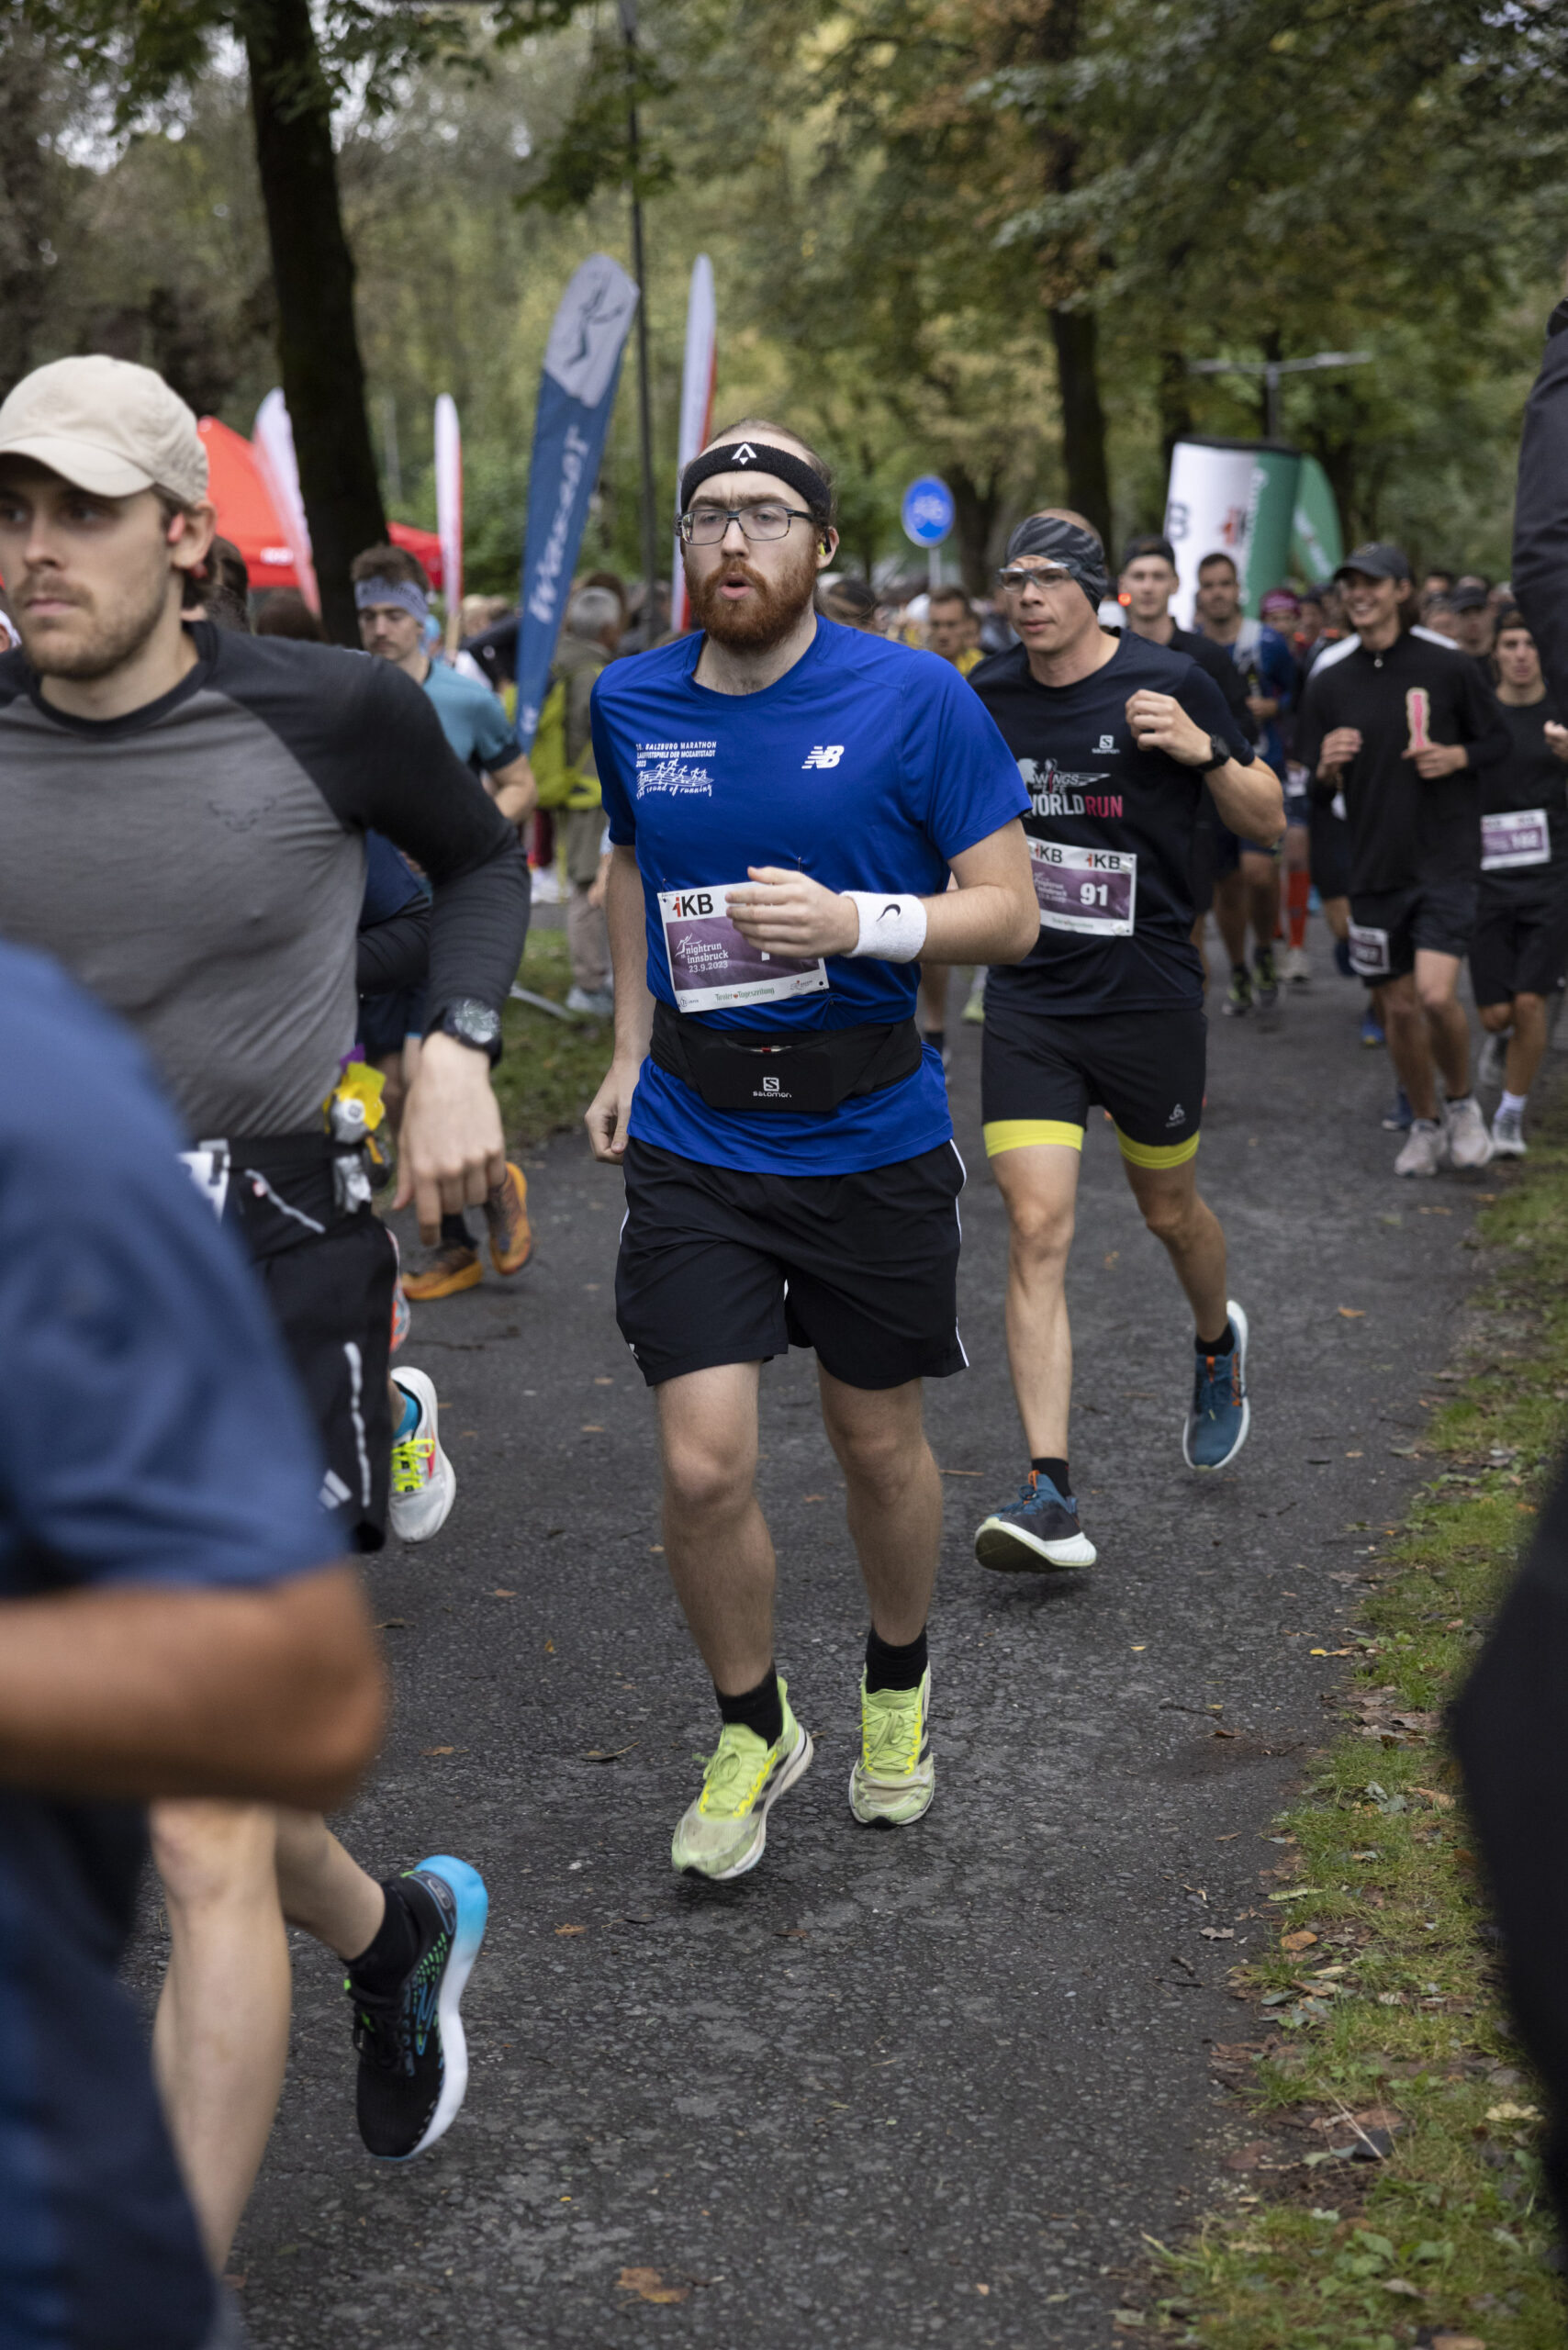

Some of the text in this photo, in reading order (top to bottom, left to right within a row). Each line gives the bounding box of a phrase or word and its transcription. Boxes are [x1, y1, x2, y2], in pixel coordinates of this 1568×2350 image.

[645, 743, 678, 751] SALZBURG
[680, 741, 717, 750] MARATHON
[680, 749, 716, 758] MOZARTSTADT
[680, 784, 712, 797] running
[1085, 794, 1124, 818] RUN
[1080, 882, 1108, 907] 91
[686, 943, 722, 956] nightrun
[687, 949, 729, 964] innsbruck
[689, 960, 729, 973] 23.9.2023
